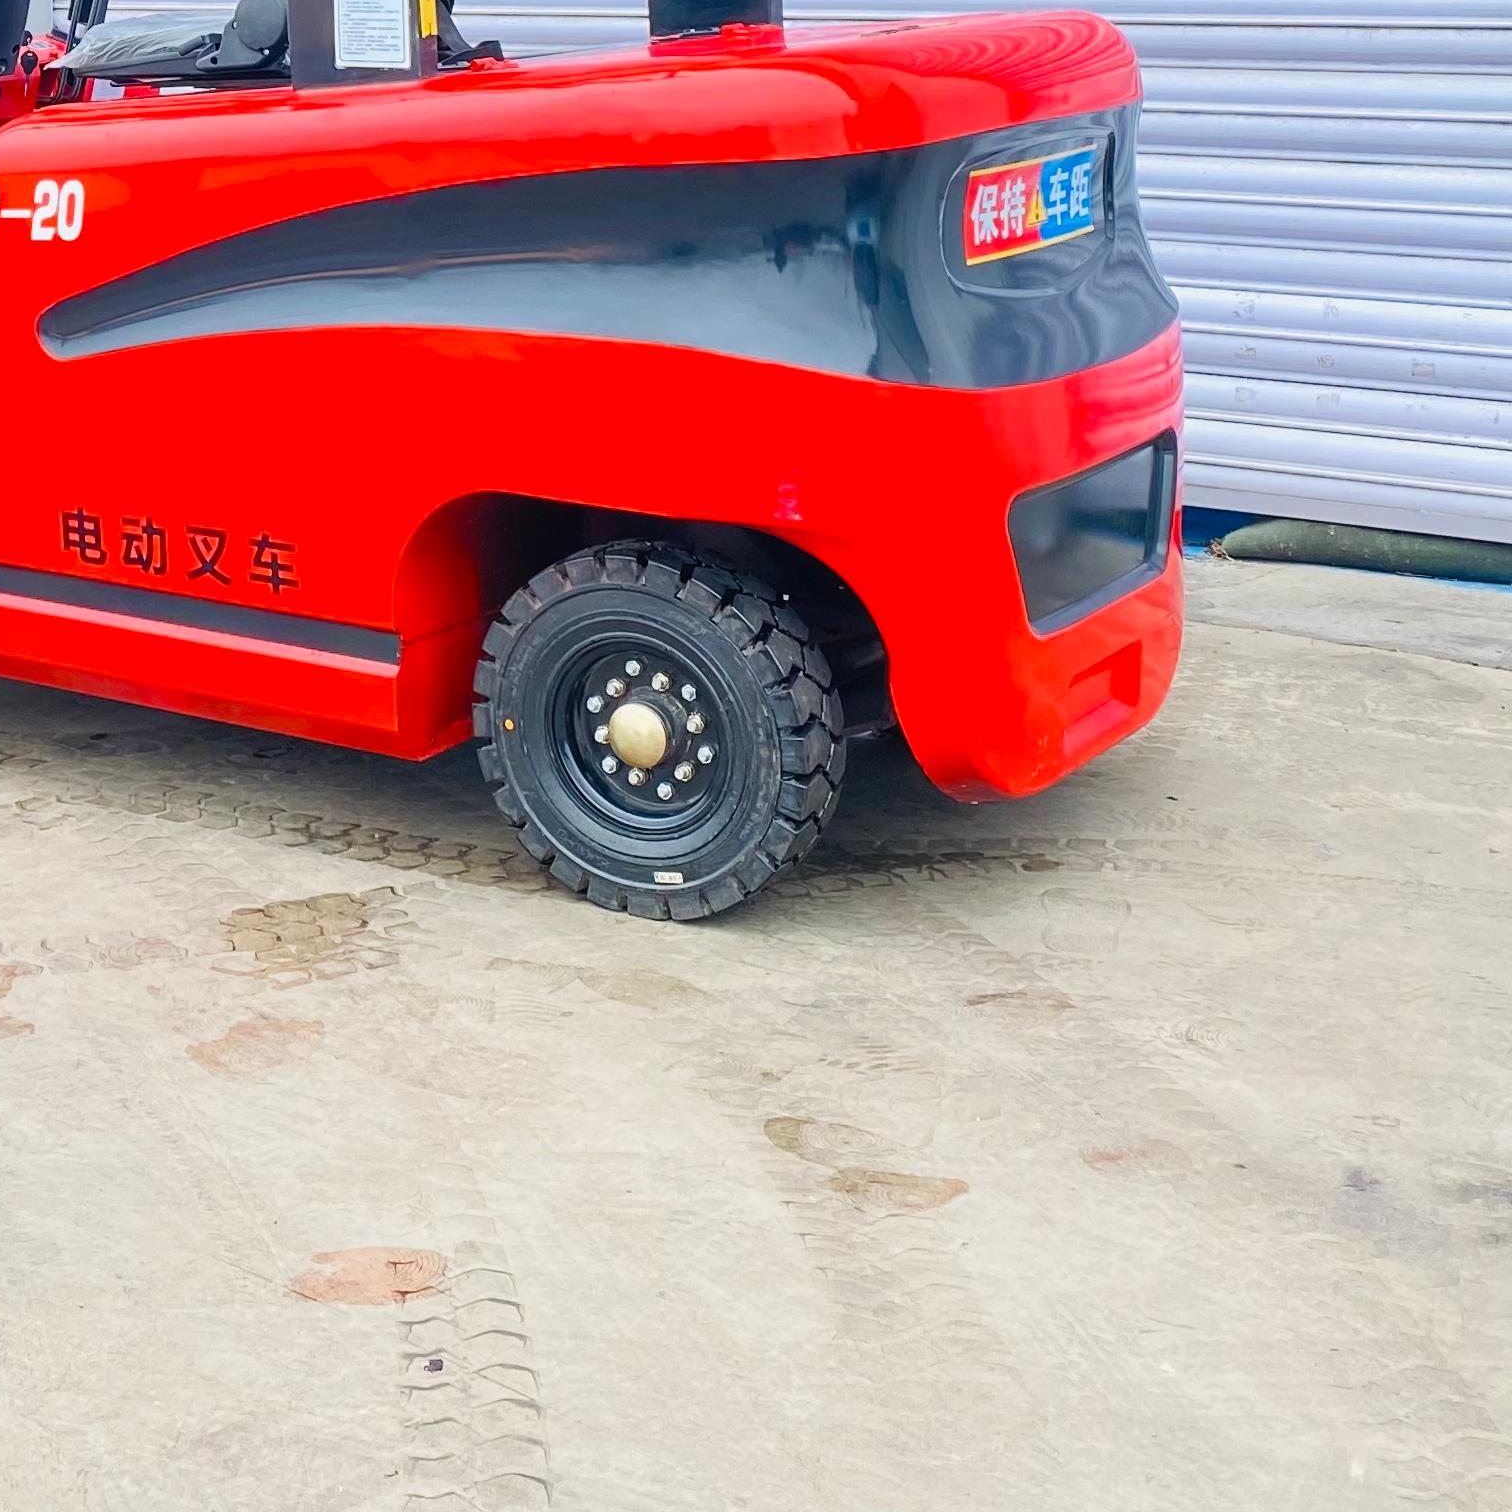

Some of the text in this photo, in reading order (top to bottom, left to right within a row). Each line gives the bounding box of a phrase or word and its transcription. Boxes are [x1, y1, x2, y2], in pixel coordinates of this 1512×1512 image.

[970, 162, 1092, 246] 保持 车距
[61, 505, 300, 595] 电动叉车
